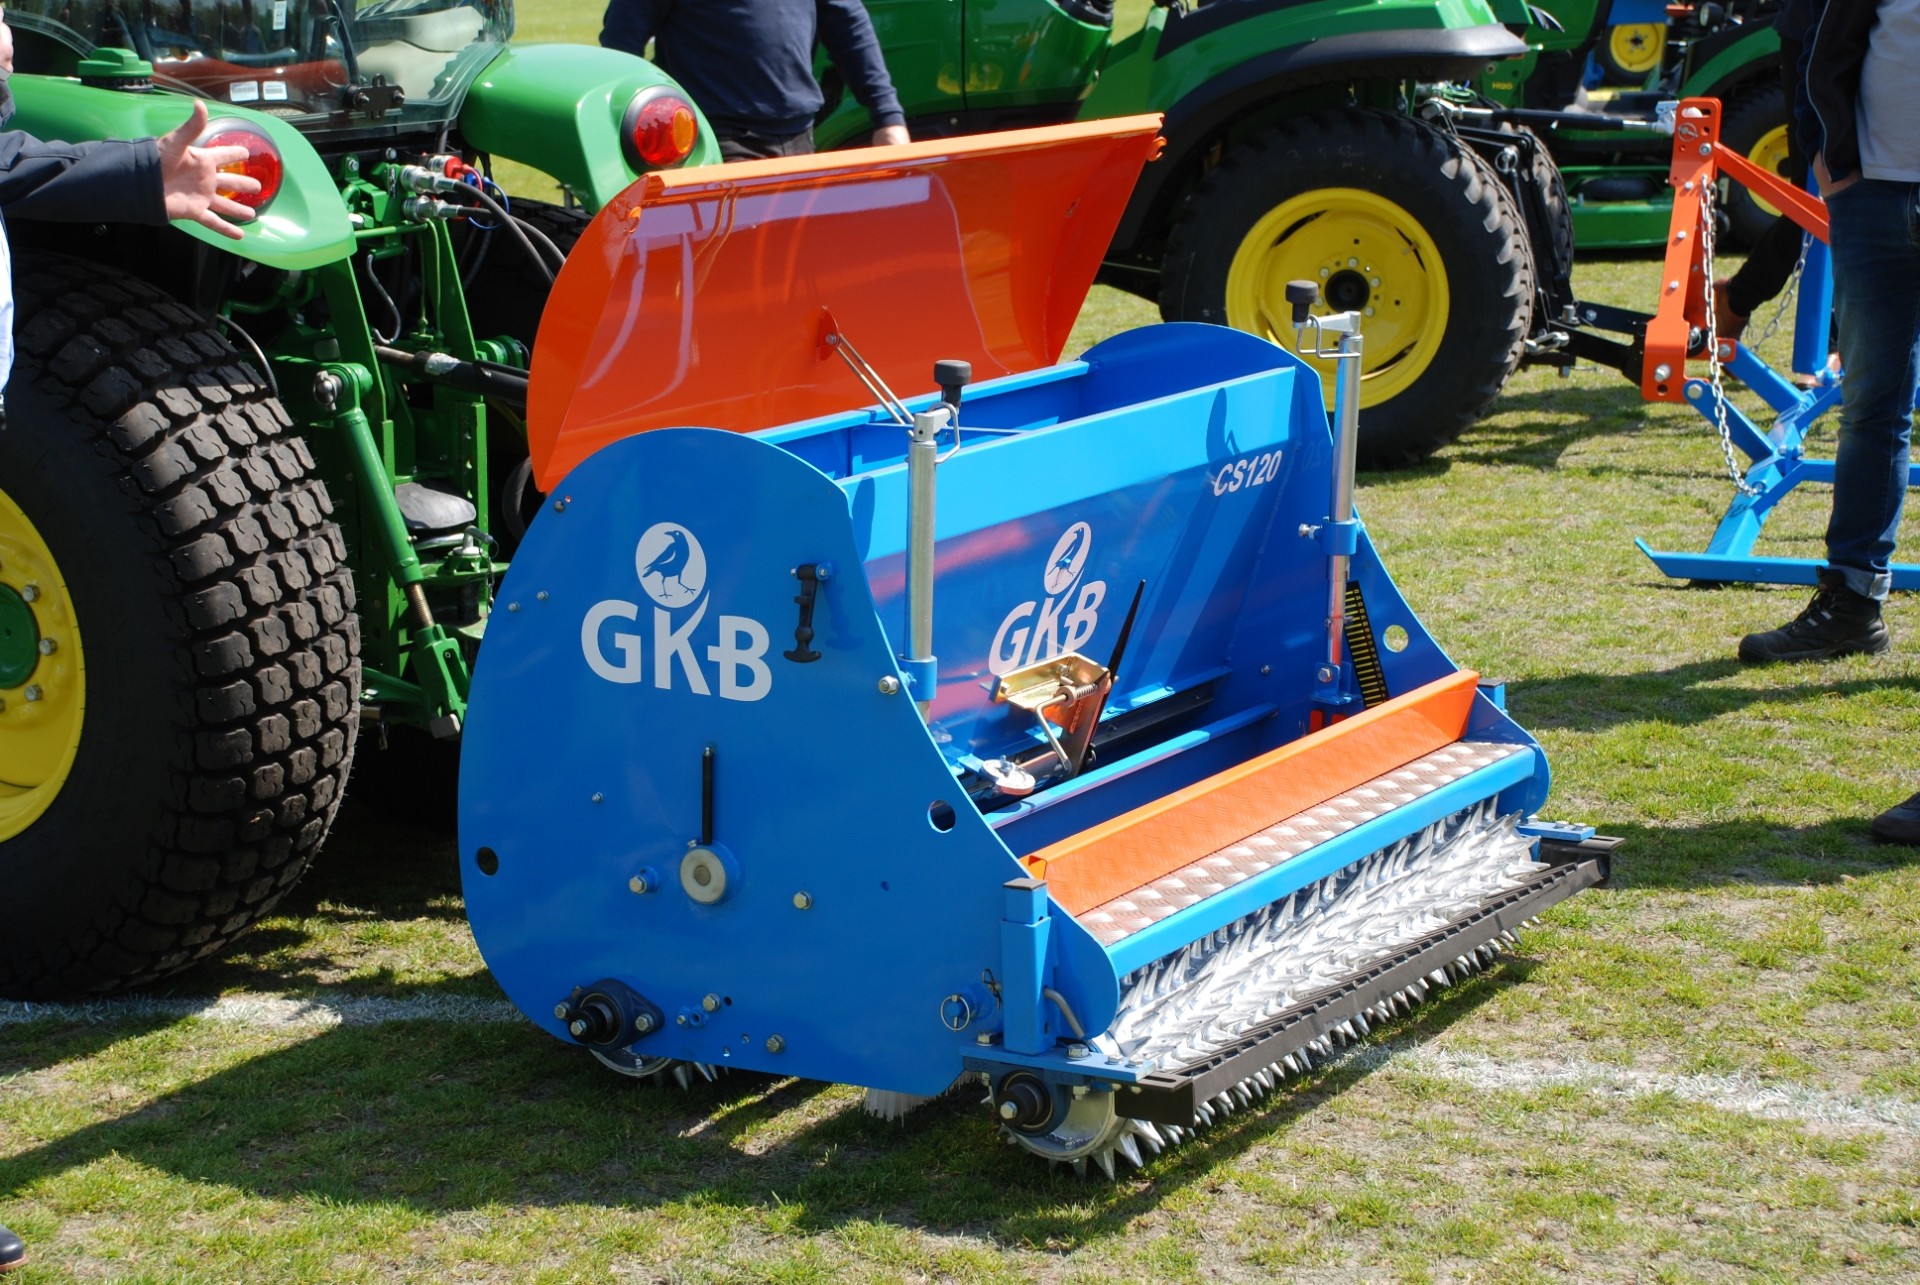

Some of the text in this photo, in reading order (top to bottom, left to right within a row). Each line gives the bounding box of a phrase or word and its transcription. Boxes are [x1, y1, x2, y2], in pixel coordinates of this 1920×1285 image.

[1213, 450, 1283, 496] CS120
[581, 590, 772, 701] GKB
[989, 568, 1106, 676] GKB
